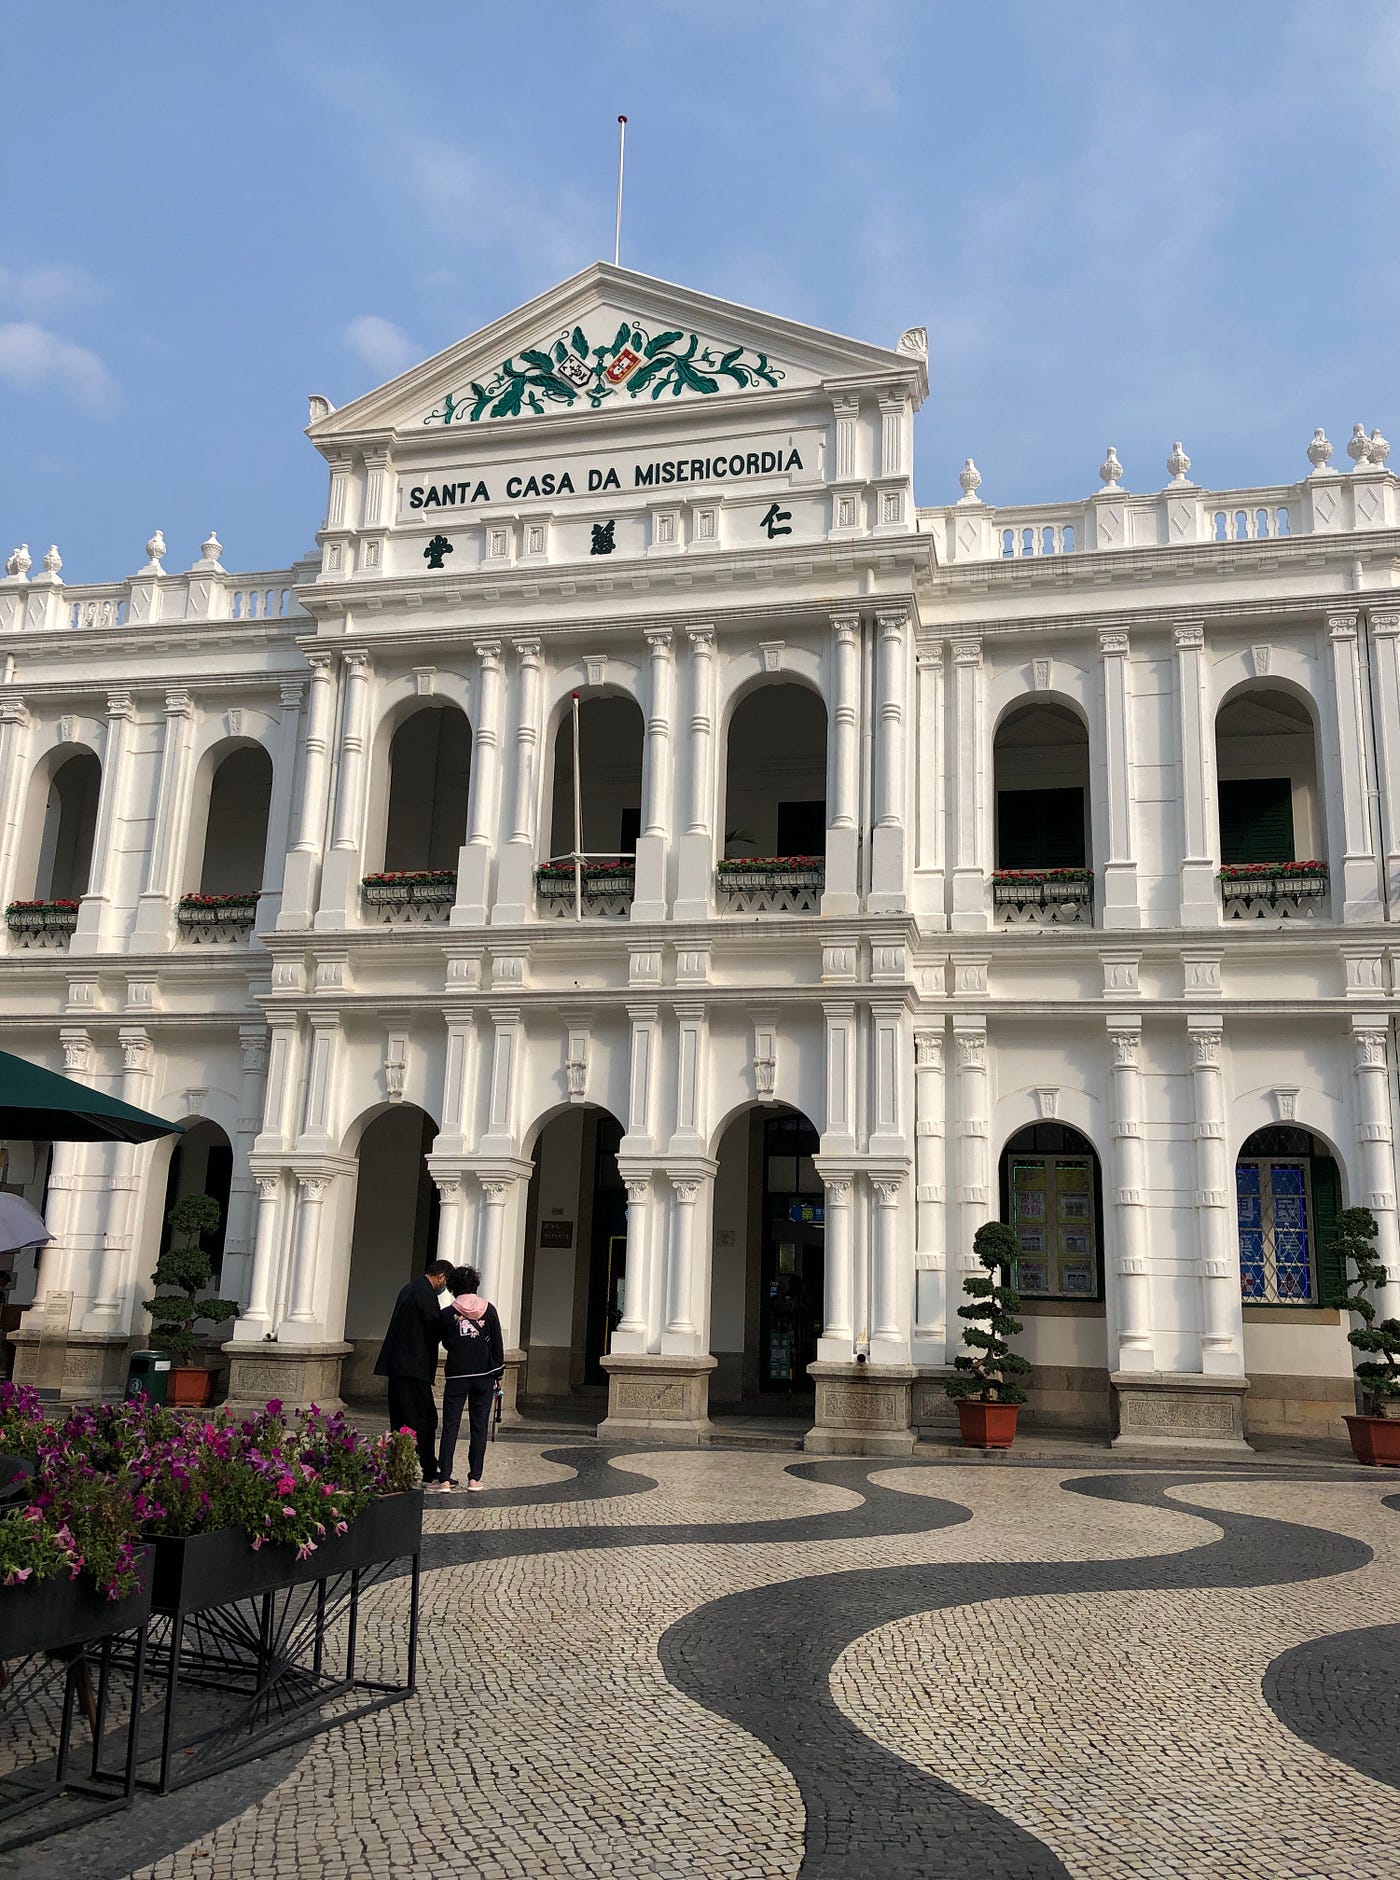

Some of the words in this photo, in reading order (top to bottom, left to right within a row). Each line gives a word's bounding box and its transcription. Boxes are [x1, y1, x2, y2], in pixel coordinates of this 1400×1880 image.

[409, 480, 491, 509] SANTA
[506, 472, 575, 499] CASA
[588, 467, 621, 492] DA
[634, 448, 804, 487] MISERICORDIA
[759, 502, 793, 540] 仁
